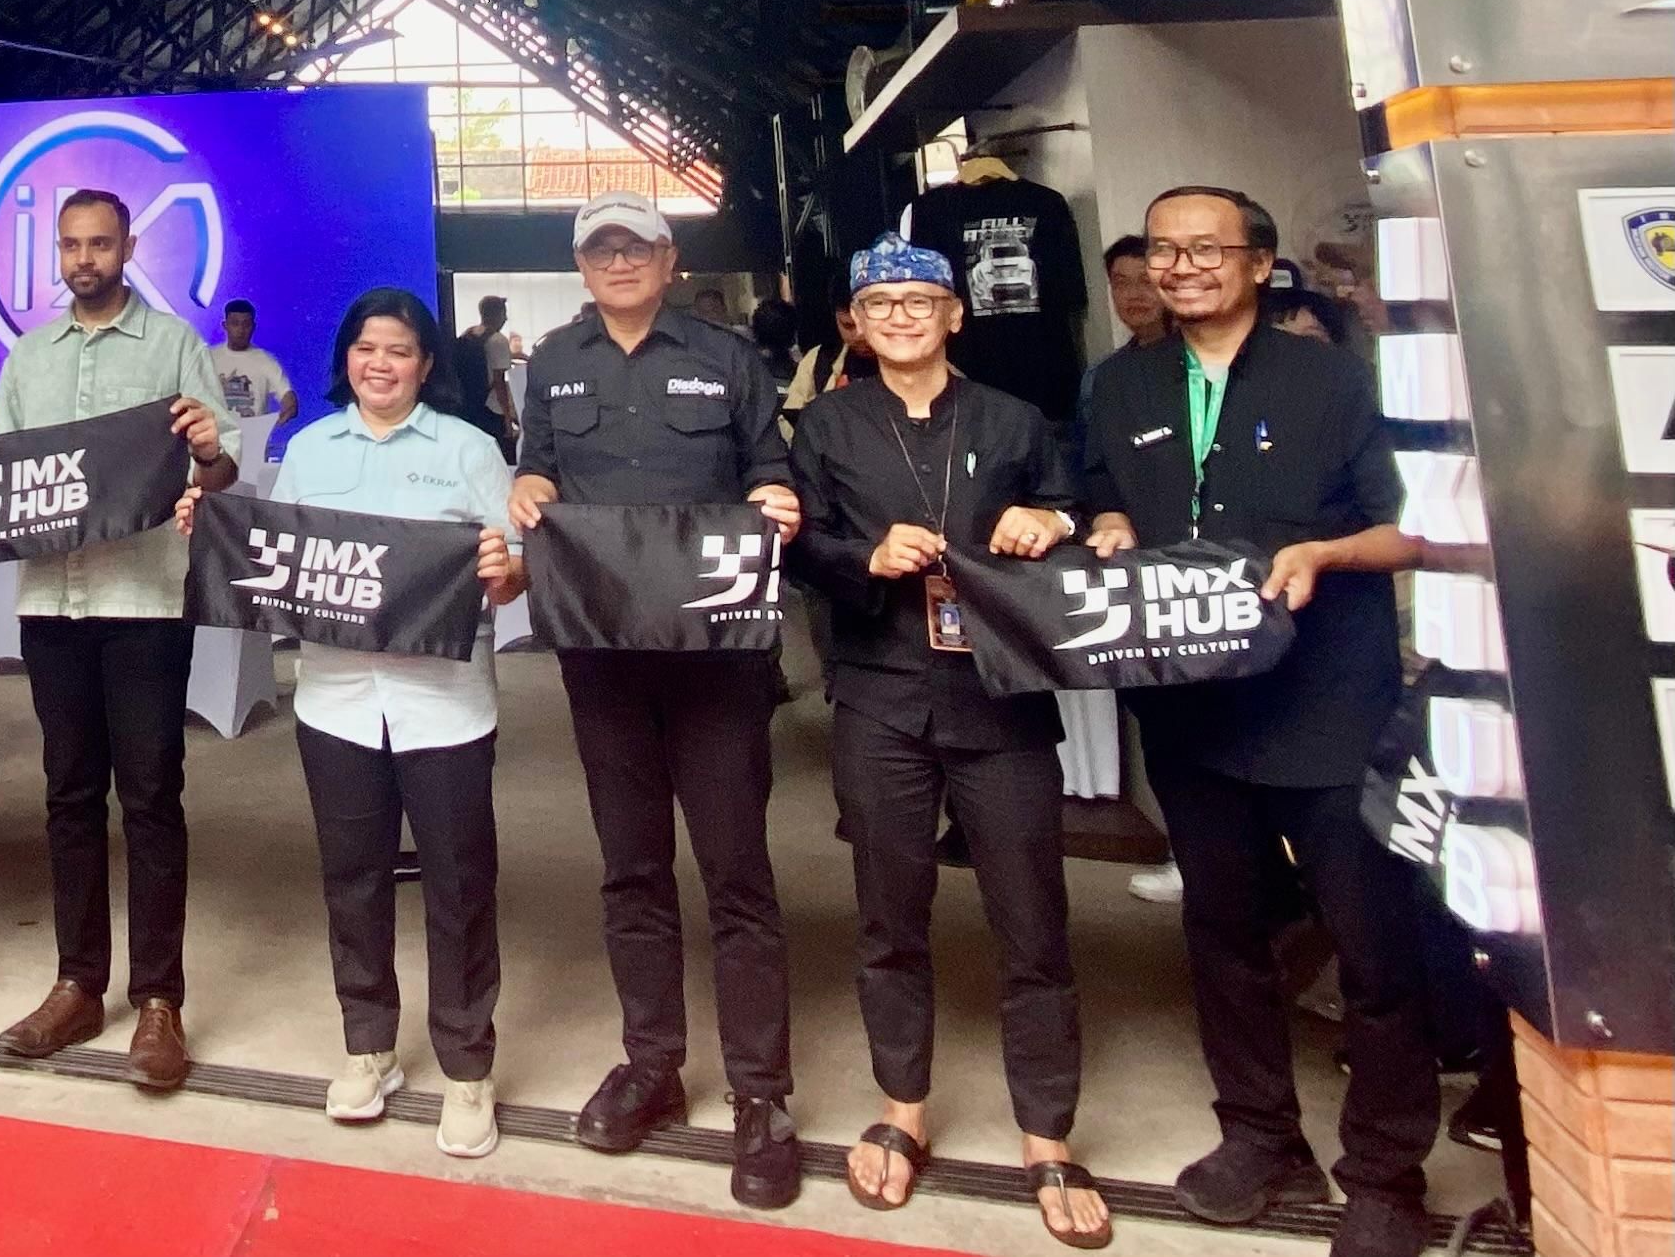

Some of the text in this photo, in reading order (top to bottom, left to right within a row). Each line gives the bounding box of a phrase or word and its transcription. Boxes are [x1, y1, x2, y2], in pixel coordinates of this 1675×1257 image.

[551, 382, 585, 397] RAN
[11, 448, 86, 492] IMX
[8, 481, 90, 523] HUB
[10, 527, 25, 538] BY
[29, 516, 79, 534] CULTURE
[300, 536, 389, 579] IMX
[295, 570, 383, 610] HUB
[1140, 557, 1255, 600] IMX
[251, 595, 366, 625] DRIVEN BY CULTURE
[710, 609, 762, 623] DRIVEN
[1145, 591, 1263, 639] HUB
[1087, 638, 1251, 665] DRIVEN BY CULTURE
[1388, 754, 1446, 864] IMX
